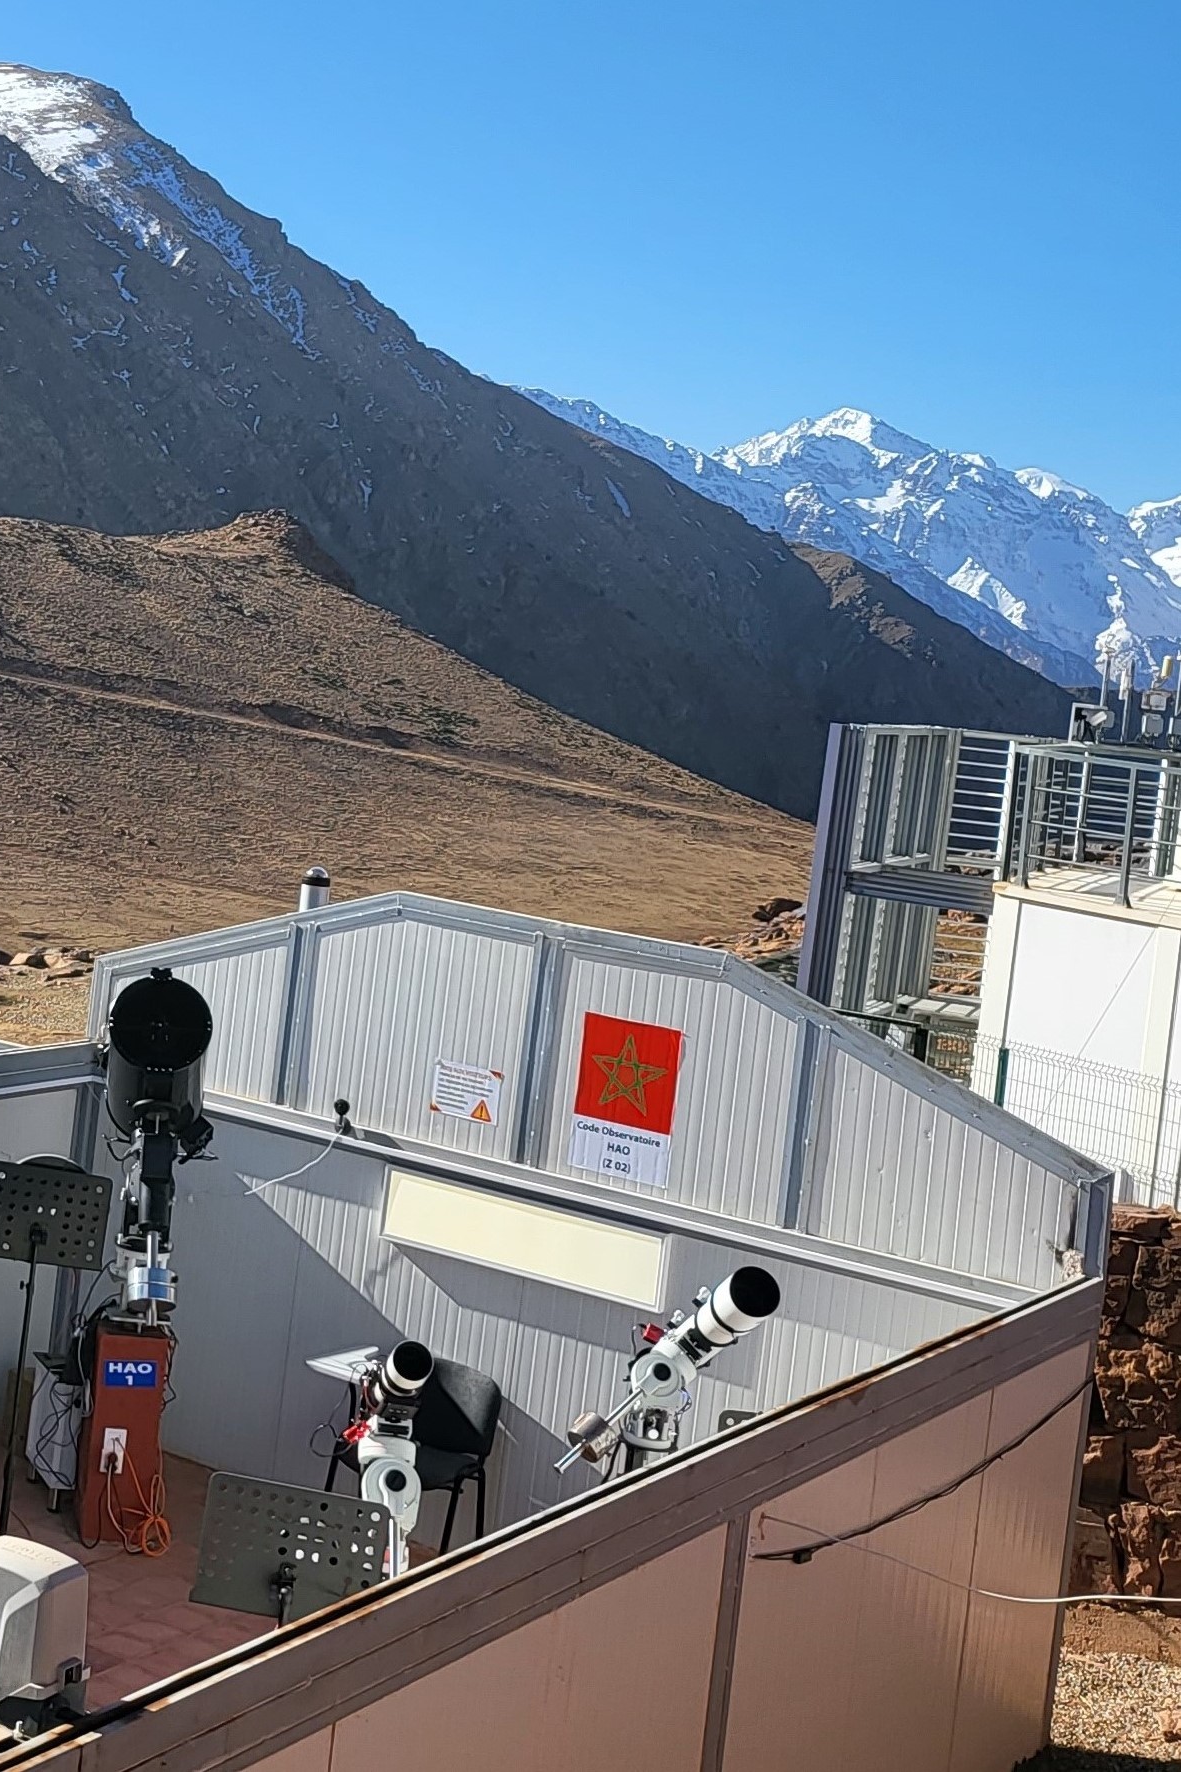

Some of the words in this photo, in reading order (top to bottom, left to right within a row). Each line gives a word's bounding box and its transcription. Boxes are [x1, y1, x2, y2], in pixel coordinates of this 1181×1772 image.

[576, 1120, 600, 1133] Code
[601, 1126, 661, 1147] Observatoire
[607, 1141, 630, 1155] HAO
[109, 1362, 153, 1374] HAO
[125, 1375, 133, 1386] 1
